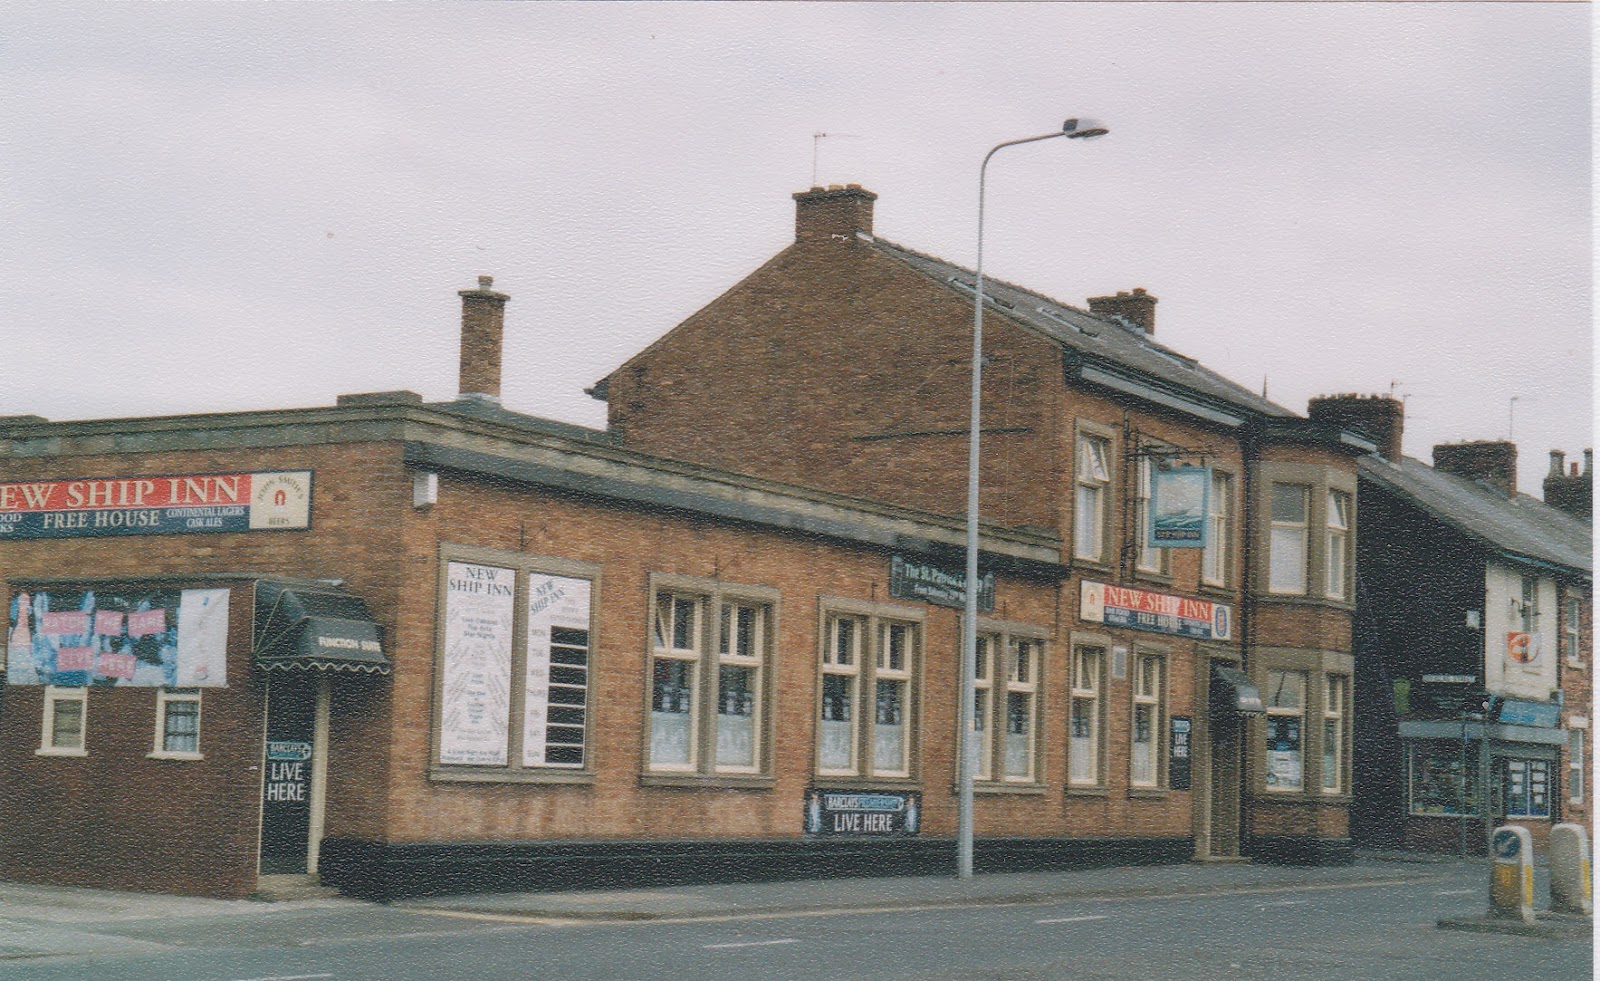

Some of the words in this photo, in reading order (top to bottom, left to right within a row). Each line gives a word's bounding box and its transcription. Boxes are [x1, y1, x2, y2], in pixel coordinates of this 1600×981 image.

[66, 480, 154, 508] SHIP
[168, 476, 240, 504] INN
[43, 511, 88, 529] FREE
[95, 507, 160, 528] HOUSE
[166, 508, 216, 518] CONTINENTAL
[217, 506, 245, 516] LAGERS
[186, 518, 204, 528] CASK
[204, 517, 223, 527] ALES
[268, 517, 290, 526] BEERS
[466, 567, 499, 580] NEW
[448, 579, 483, 593] SHIP
[487, 583, 513, 596] INN
[535, 580, 553, 597] NEW
[530, 596, 549, 615] SHIP
[550, 587, 566, 604] INN
[1107, 586, 1143, 608] NEW
[1147, 592, 1179, 614] SHIP
[1183, 602, 1209, 621] INN
[1136, 611, 1155, 626] FREE
[318, 636, 359, 649] FUNCTION
[271, 763, 304, 781] LIVE
[267, 783, 306, 801] HERE
[827, 796, 859, 808] BARCLAYS
[834, 813, 860, 832] LIVE
[864, 814, 893, 832] HERE
